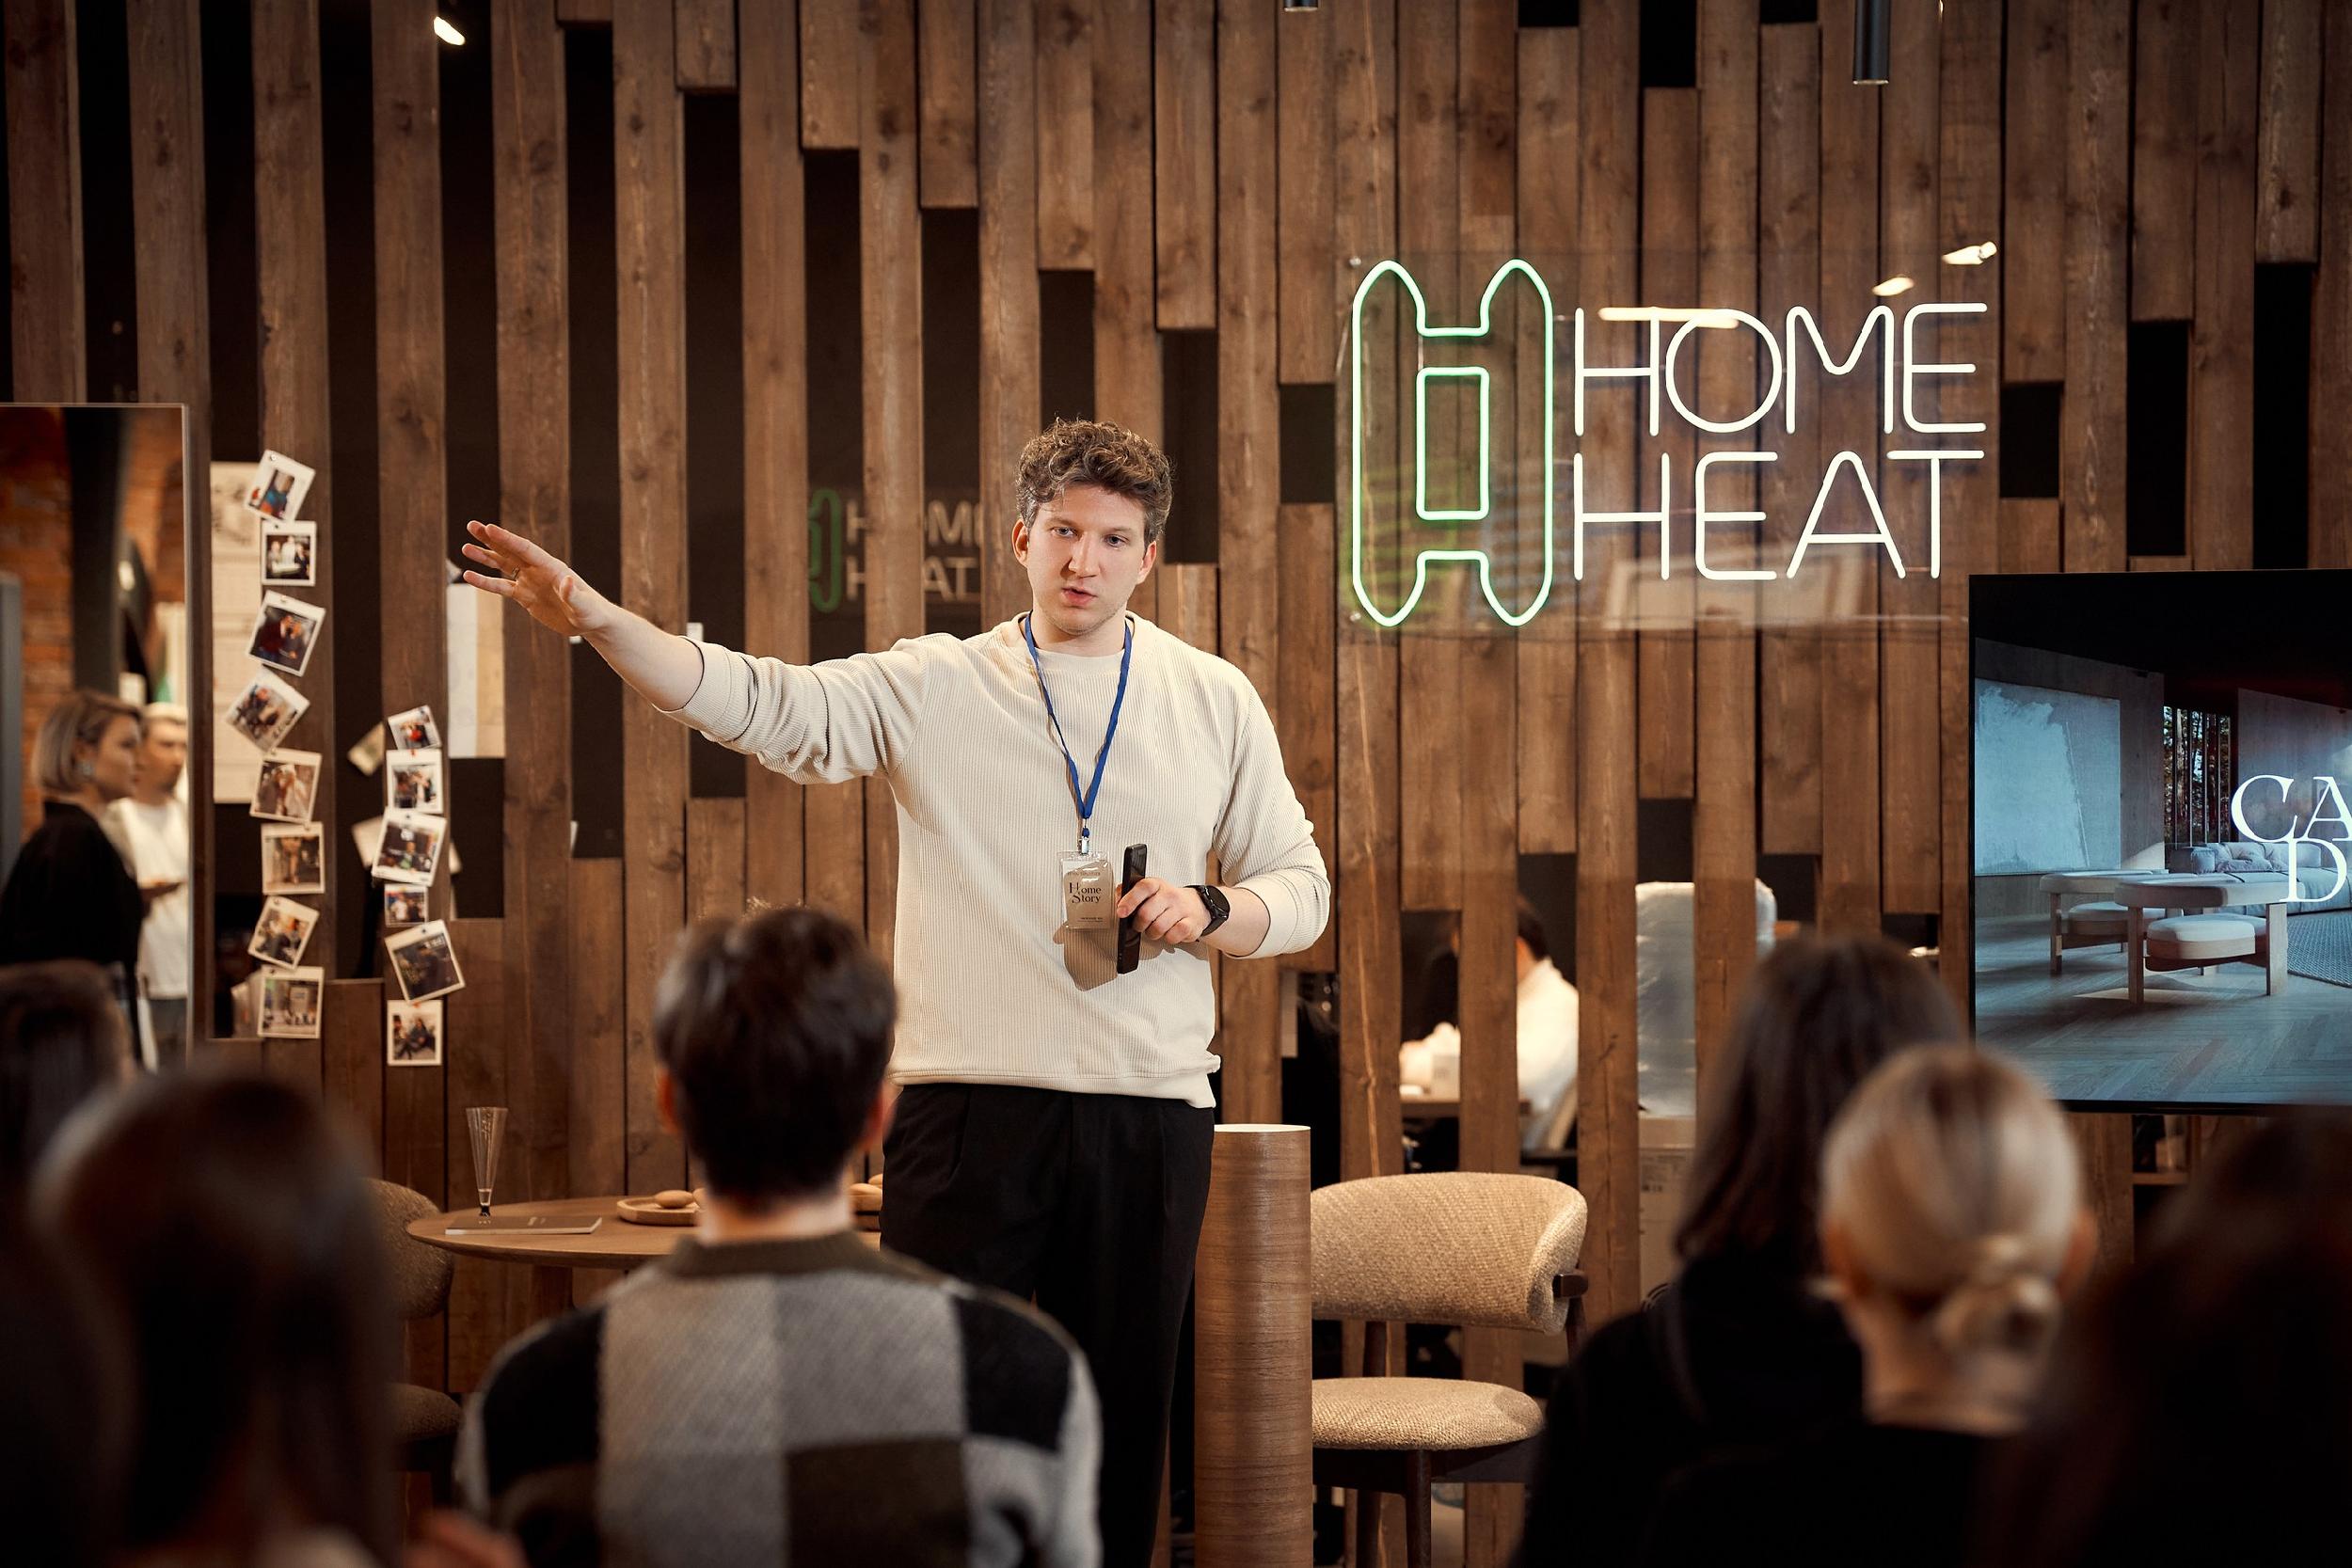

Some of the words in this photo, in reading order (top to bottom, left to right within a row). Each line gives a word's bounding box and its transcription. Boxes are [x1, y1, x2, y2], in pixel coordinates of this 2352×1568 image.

[1573, 302, 1989, 437] HOME
[847, 499, 982, 546] HM
[1572, 450, 1985, 581] HEAT
[847, 555, 977, 601] HAT
[2231, 774, 2352, 843] CA
[1069, 881, 1102, 895] Home
[2279, 837, 2347, 903] D
[1072, 894, 1101, 904] Story
